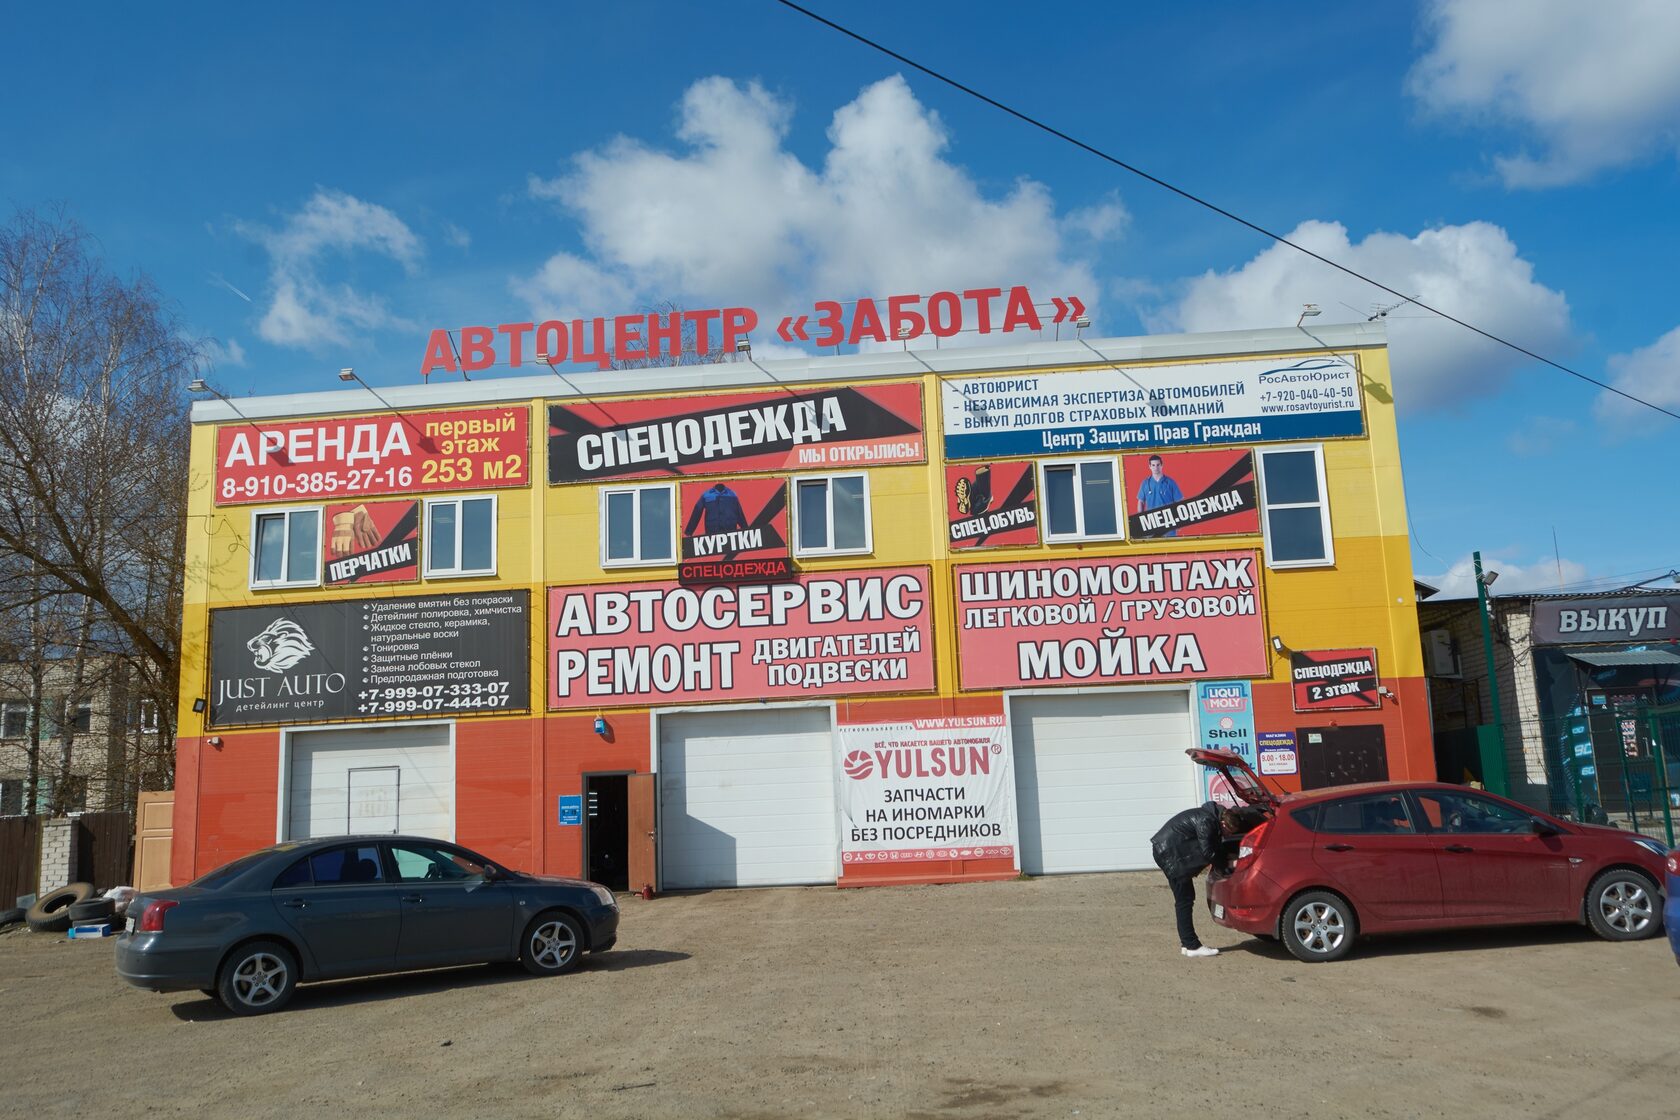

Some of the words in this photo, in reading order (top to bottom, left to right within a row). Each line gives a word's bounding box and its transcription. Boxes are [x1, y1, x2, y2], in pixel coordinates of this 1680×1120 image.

[421, 306, 758, 376] АВТОЦЕНТР
[776, 285, 1086, 347] «ЗАБОТА»
[963, 379, 1039, 395] АВТОЮРИСТ
[1258, 371, 1351, 385] РосАвтоЮрист
[964, 395, 1059, 412] НЕЗАВИСИМАЯ
[1063, 389, 1145, 406] ЭКСПЕРТИЗА
[1149, 381, 1245, 400] АВТОМОБИЛЕЙ
[1260, 386, 1354, 402] +7-920-040-40-50
[964, 414, 1009, 429] ВЫКУП
[1013, 411, 1065, 427] ДОЛГОВ
[1069, 406, 1147, 422] СТРАХОВЫХ
[1152, 400, 1225, 418] КОМПАНИЙ
[1261, 400, 1355, 413] www.rosavtoyurist.ru
[425, 412, 516, 438] первый
[576, 396, 847, 472] СПЕЦОДЕЖДА
[1042, 428, 1085, 449] Центр
[1089, 424, 1149, 445] Защиты
[1154, 424, 1190, 444] Прав
[1194, 421, 1262, 440] Граждан
[224, 422, 411, 468] АРЕНДА
[441, 436, 500, 455] этаж
[798, 447, 827, 464] МЫ
[829, 442, 920, 461] ОТКРЫЛИСЬ!
[422, 457, 473, 484] 253
[483, 455, 522, 480] м2
[221, 466, 413, 499] 8-910-385-27-16
[1139, 489, 1244, 532] МЕД.ОДЕЖДА
[950, 506, 1036, 540] СПЕЦ.ОБУВЬ
[693, 528, 763, 557] КУРТКИ
[329, 543, 412, 582] ПЕРЧАТКИ
[682, 561, 787, 579] СПЕЦОДЕЖДА
[960, 557, 1254, 602] ШИНОМОНТАЖ
[371, 602, 416, 612] Удаление
[418, 600, 451, 609] вмятин
[453, 598, 470, 607] без
[471, 596, 513, 607] покраски
[371, 612, 419, 622] Детейлинг
[421, 609, 472, 619] полировка,
[474, 605, 522, 616] химчистка
[556, 575, 923, 637] АВТОСЕРВИС
[964, 597, 1096, 629] ЛЕГКОВОЙ
[1121, 589, 1256, 623] ГРУЗОВОЙ
[371, 623, 407, 632] Жидкое
[409, 620, 442, 630] стекло,
[444, 618, 490, 629] керамика,
[371, 632, 431, 643] натуральные
[433, 630, 459, 639] воски
[753, 625, 921, 665] ДВИГАТЕЛЕЙ
[371, 643, 420, 653] Тонировка
[371, 653, 418, 663] Защитные
[420, 651, 453, 660] плёнки
[1018, 626, 1206, 681] МОЙКА
[371, 664, 405, 673] Замена
[407, 661, 447, 672] лобовых
[450, 660, 481, 669] стекол
[558, 641, 740, 698] РЕМОНТ
[767, 657, 908, 689] ПОДВЕСКИ
[1294, 660, 1372, 680] СПЕЦОДЕЖДА
[371, 672, 445, 685] Предпродажная
[447, 669, 499, 681] подготовка
[217, 677, 271, 706] JUST
[277, 672, 346, 697] AUTO
[358, 682, 510, 700] +7-999-07-333-07
[1209, 688, 1240, 698] LIQUI
[1312, 686, 1323, 700] 2
[1326, 681, 1360, 697] этаж
[236, 701, 289, 712] детейлинг
[294, 699, 325, 709] центр
[358, 695, 510, 713] +7-999-07-444-07
[1209, 698, 1240, 708] MOLY
[916, 715, 1003, 729] WWW.YULSUN.RU
[888, 740, 899, 748] ЧТО
[900, 738, 928, 748] КАСАЕТСЯ
[929, 738, 952, 746] ВАШЕГО
[953, 737, 990, 745] АВТОМОБИЛЯ
[1208, 728, 1247, 738] Shell
[884, 787, 965, 803] ЗАПЧАСТИ
[866, 808, 888, 822] НА
[893, 805, 985, 821] ИНОМАРКИ
[851, 828, 878, 842] БЕЗ
[883, 823, 1002, 841] ПОСРЕДНИКОВ
